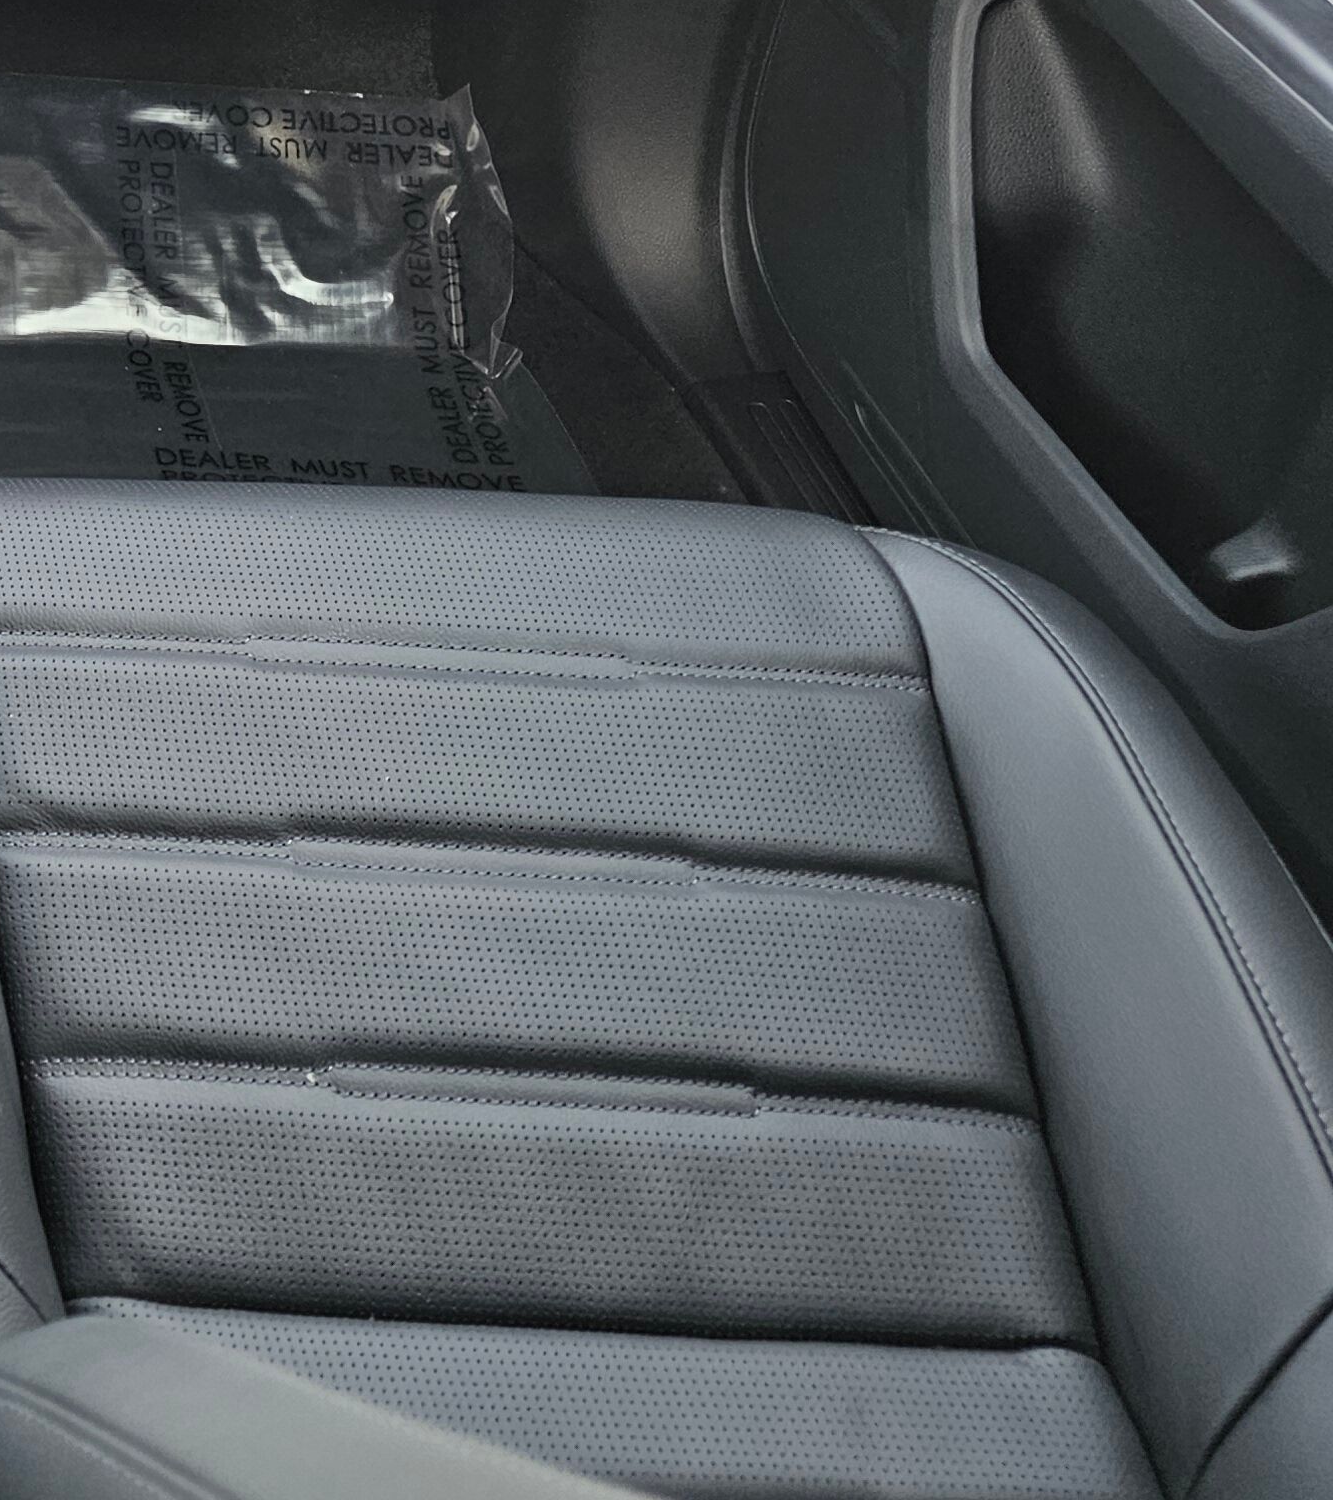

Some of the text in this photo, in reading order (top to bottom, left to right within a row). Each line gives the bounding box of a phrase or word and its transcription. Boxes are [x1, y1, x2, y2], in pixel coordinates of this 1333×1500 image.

[282, 108, 451, 141] PROTECTIVE
[115, 126, 454, 168] DEALER MUST REMOVE
[400, 174, 434, 289] REMOVE
[154, 446, 271, 472] DEALER
[289, 457, 370, 482] MUST
[388, 463, 528, 493] REMOVE
